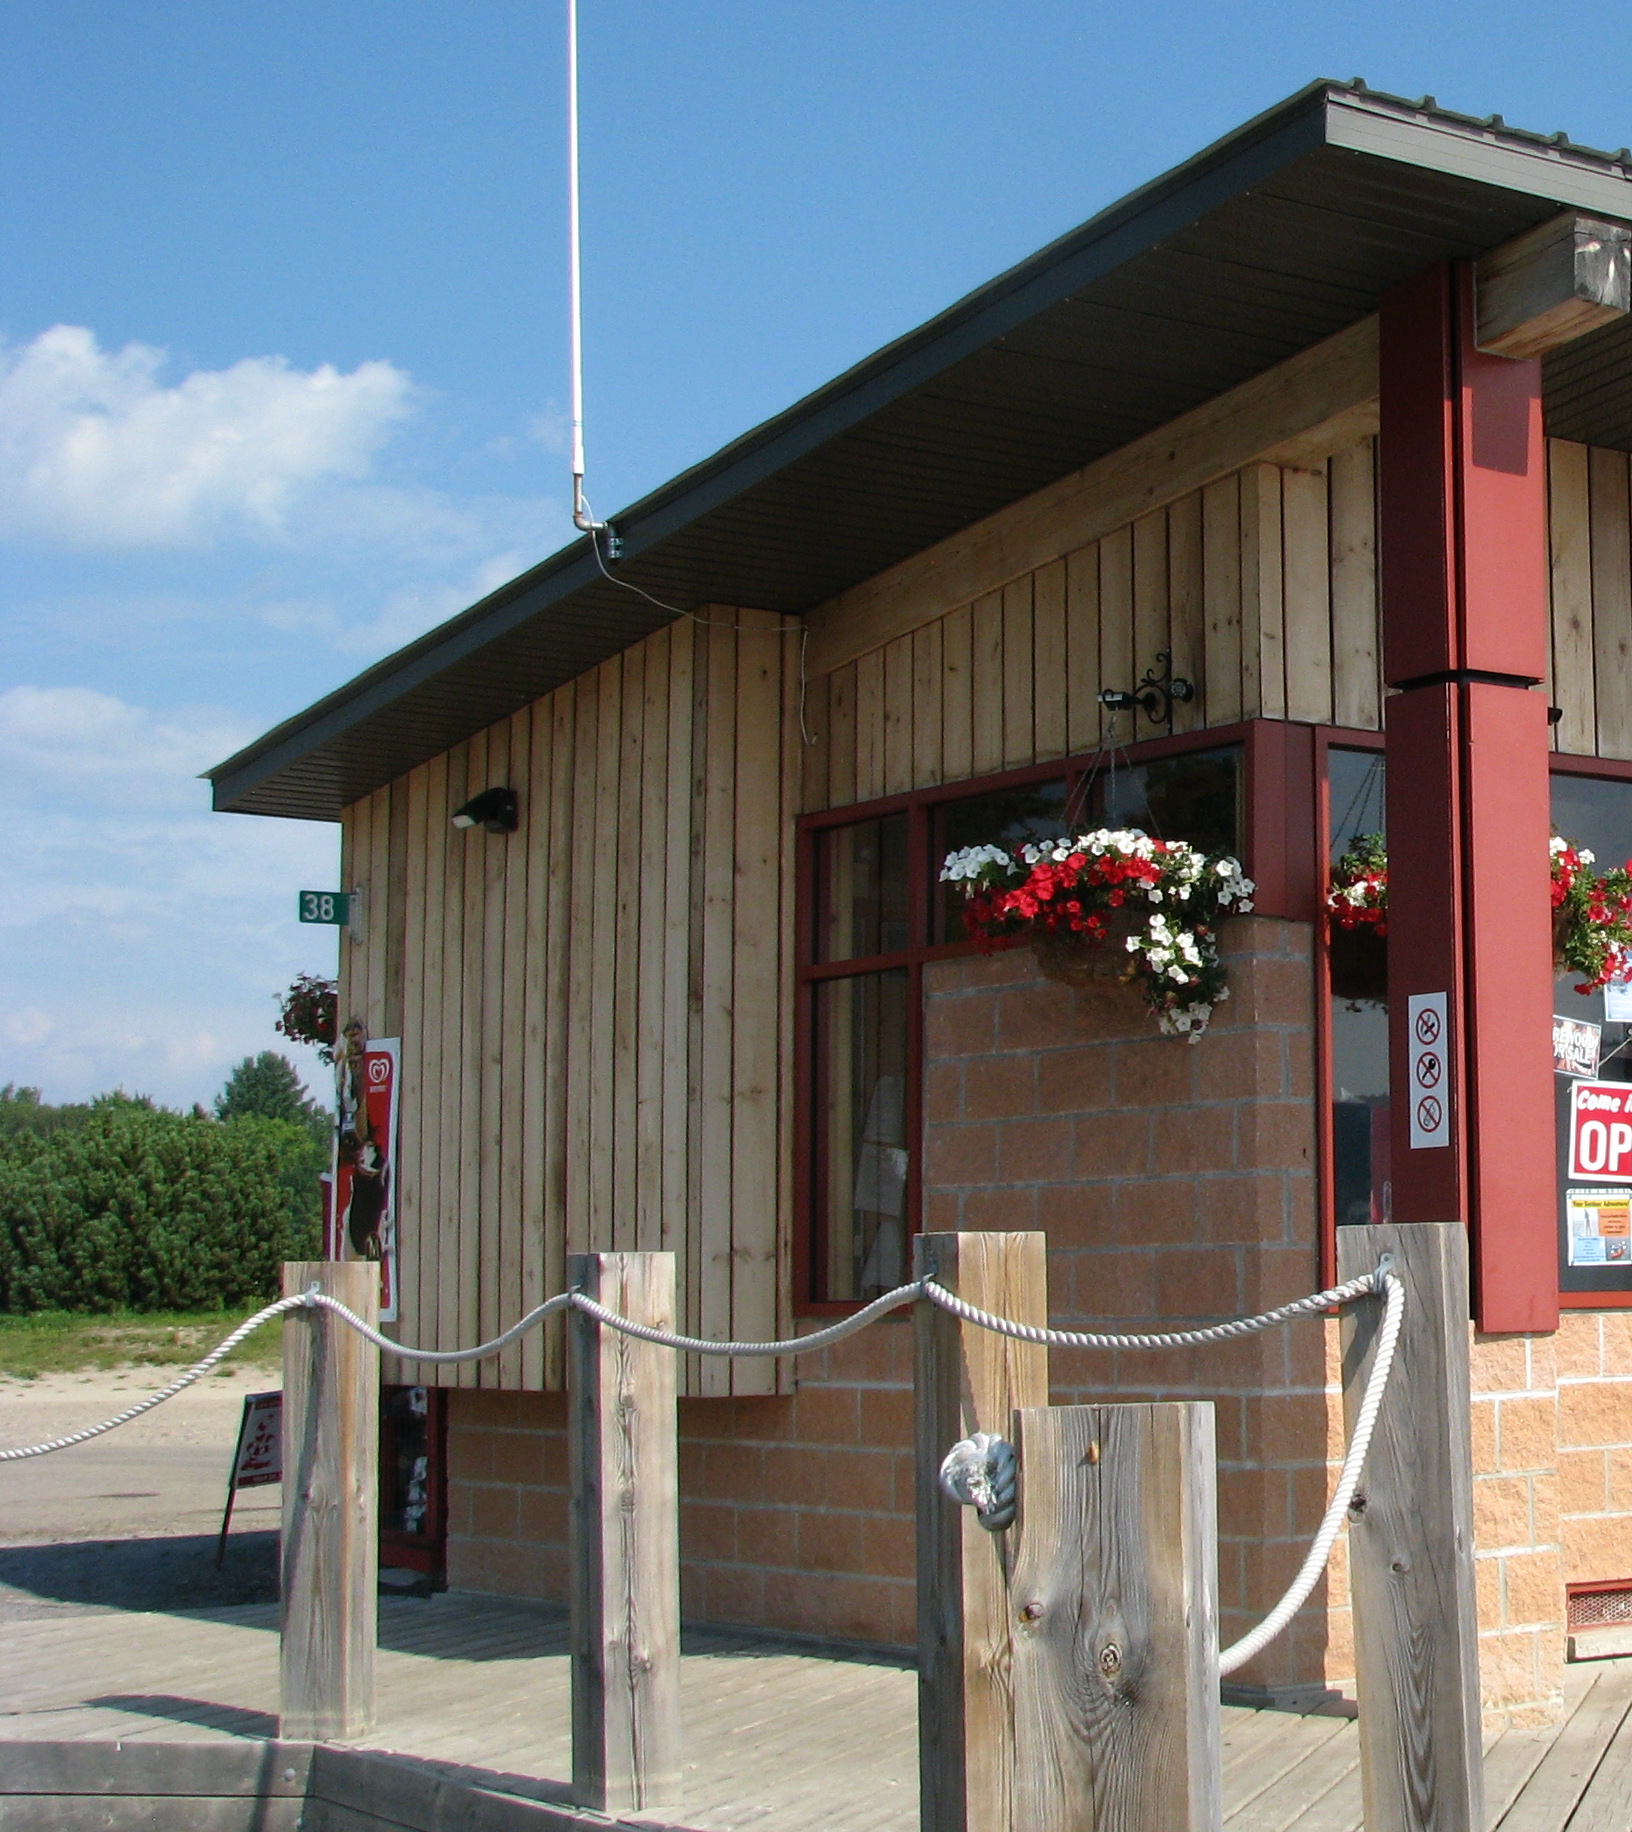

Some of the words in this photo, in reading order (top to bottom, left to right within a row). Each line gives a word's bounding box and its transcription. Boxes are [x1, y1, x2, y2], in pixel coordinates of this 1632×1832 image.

[303, 894, 334, 920] 38
[1566, 1045, 1592, 1065] SALE
[1577, 1089, 1621, 1113] Come
